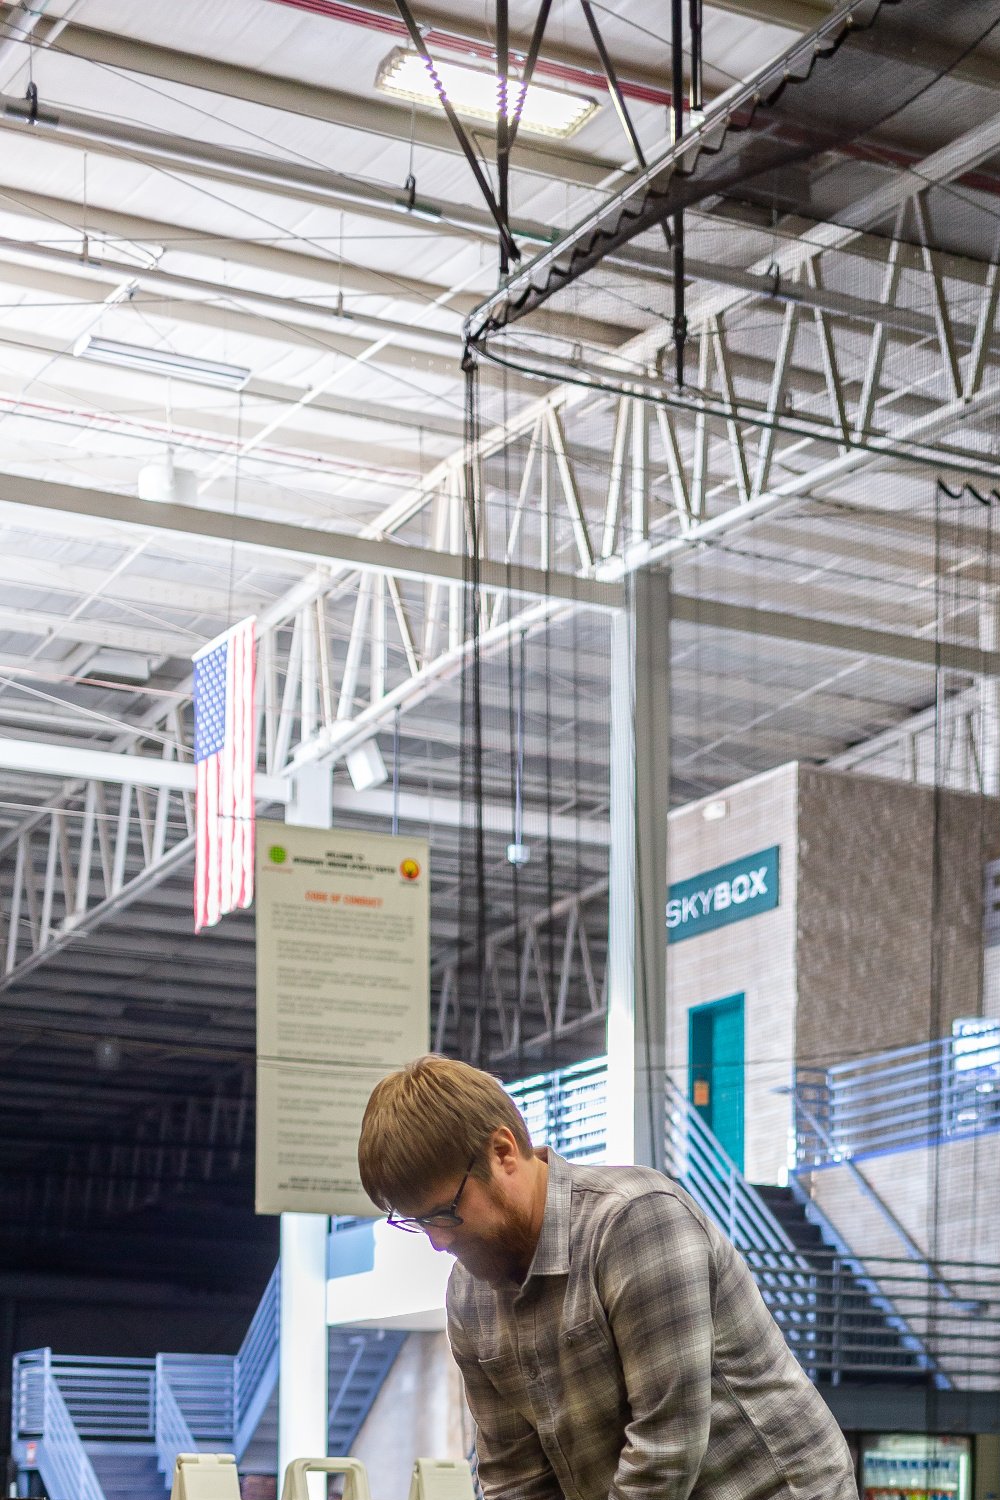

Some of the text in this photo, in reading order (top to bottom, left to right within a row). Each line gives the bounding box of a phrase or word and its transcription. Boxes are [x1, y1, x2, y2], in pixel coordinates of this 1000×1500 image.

[304, 890, 328, 903] CODE
[342, 894, 384, 909] CONDUCT
[666, 866, 768, 928] SKYBOX
